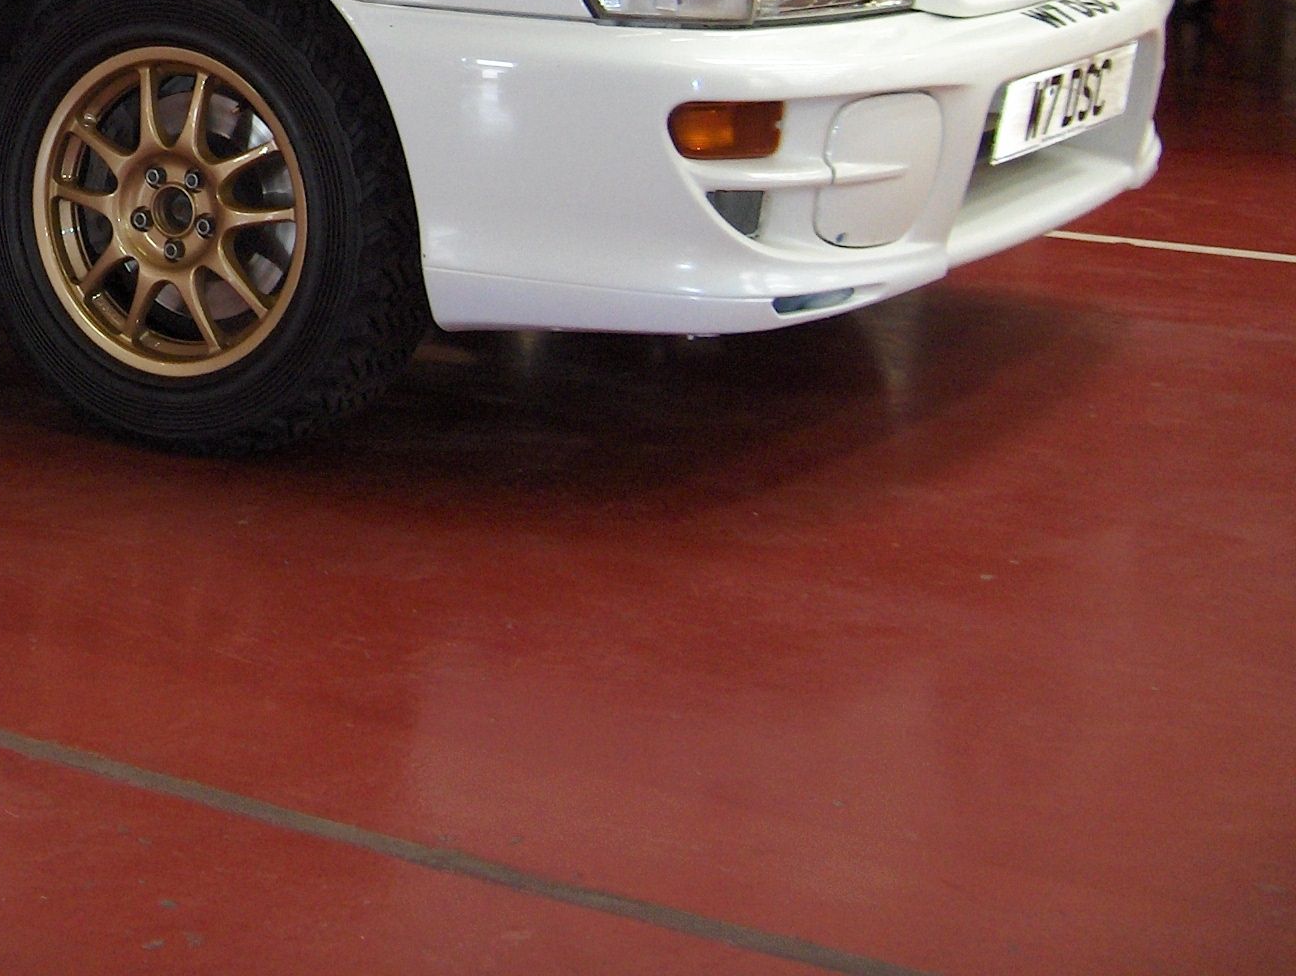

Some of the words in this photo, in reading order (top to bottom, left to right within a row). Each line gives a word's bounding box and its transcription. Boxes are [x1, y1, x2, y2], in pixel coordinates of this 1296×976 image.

[1021, 4, 1077, 28] W7
[1025, 73, 1065, 142] W7
[1061, 58, 1113, 128] DSC
